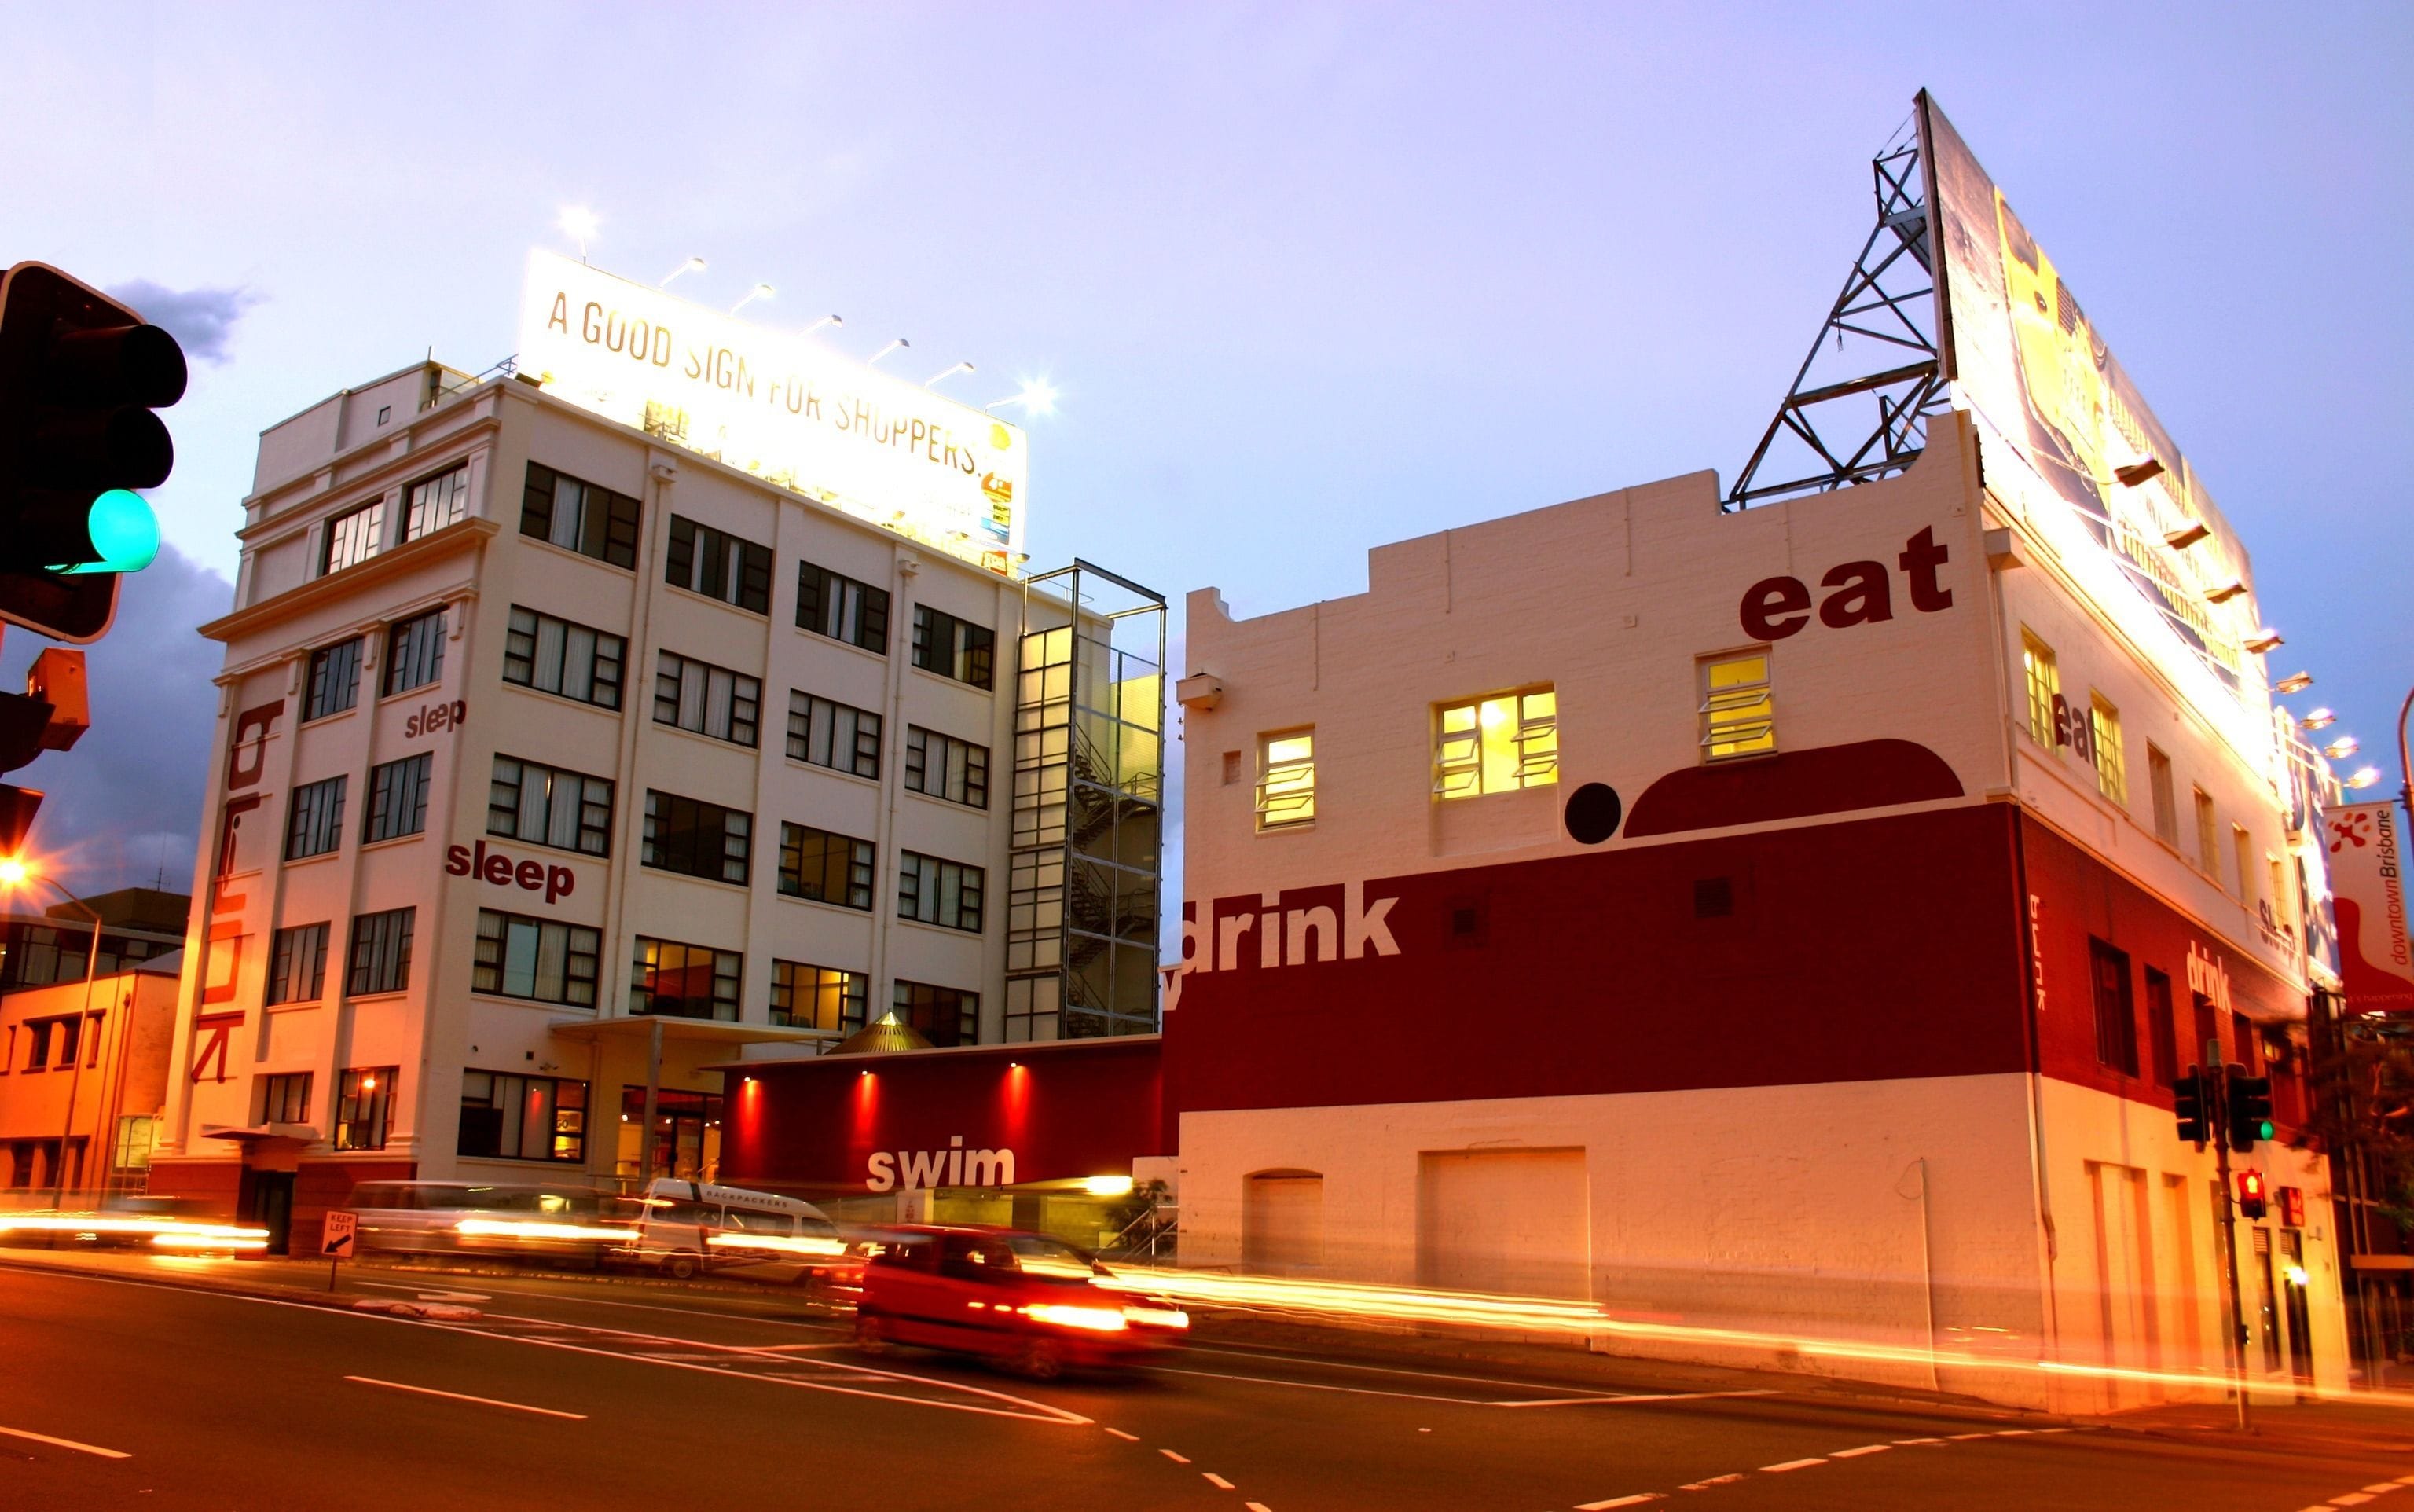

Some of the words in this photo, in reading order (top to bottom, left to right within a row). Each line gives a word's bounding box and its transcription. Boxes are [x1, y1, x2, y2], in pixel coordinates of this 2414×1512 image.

[548, 292, 567, 334] A
[582, 301, 672, 368] GOOD
[684, 345, 754, 398] SIGN
[1740, 525, 1953, 641] eat
[405, 699, 467, 739] sleep
[446, 839, 575, 905] sleep
[1181, 881, 1402, 976] drink
[2187, 939, 2232, 1015] drink
[866, 1135, 1015, 1192] swim
[330, 1224, 350, 1233] LEFT
[331, 1214, 354, 1224] KEEP
[706, 1190, 788, 1209] BACKPACKERS
